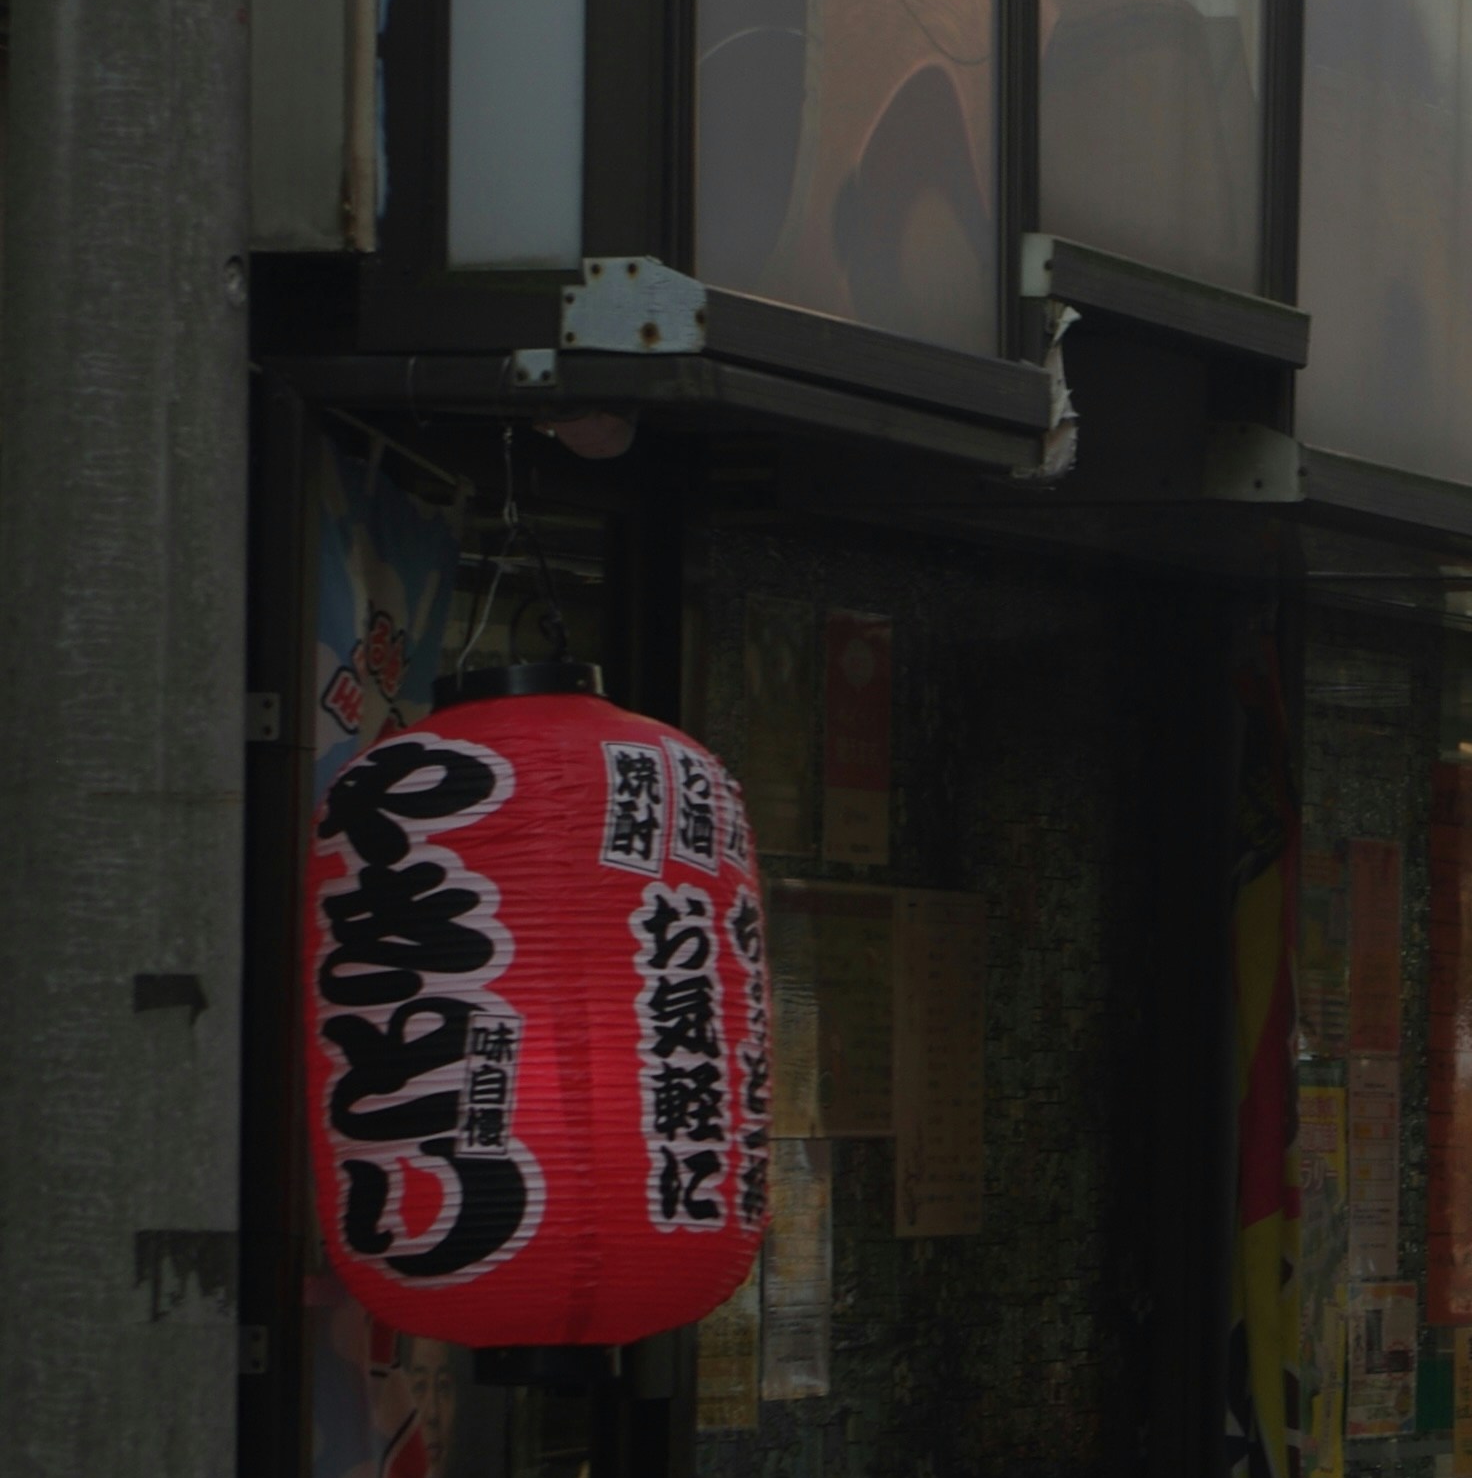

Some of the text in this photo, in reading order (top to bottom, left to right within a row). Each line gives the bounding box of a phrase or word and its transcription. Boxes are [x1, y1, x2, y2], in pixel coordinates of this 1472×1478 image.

[610, 750, 661, 863] 焼酎
[677, 753, 716, 858] お酒
[316, 740, 528, 1277] やきとり
[644, 894, 723, 1223] お気軽に
[466, 1022, 518, 1149] 味自慢
